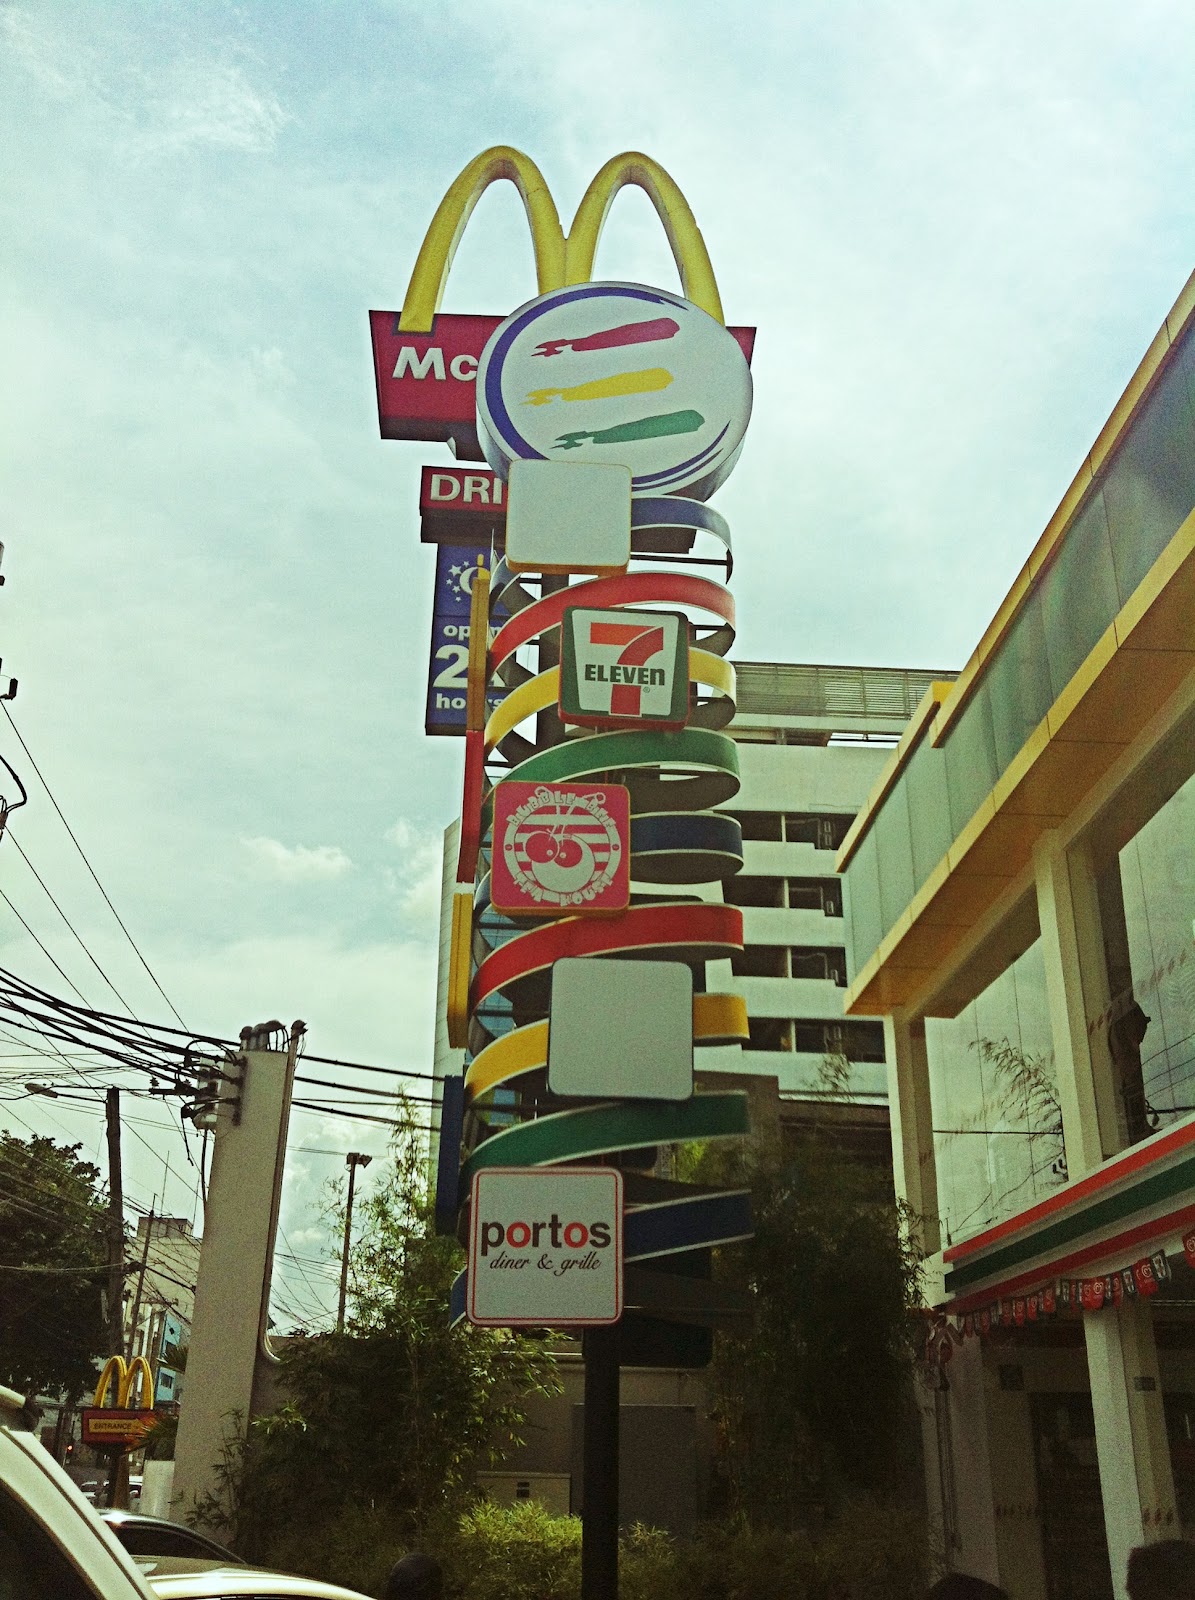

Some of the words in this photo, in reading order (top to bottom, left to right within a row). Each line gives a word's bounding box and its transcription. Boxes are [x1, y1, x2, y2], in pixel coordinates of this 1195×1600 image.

[392, 346, 479, 381] Mc
[430, 474, 503, 504] DRI
[480, 1214, 612, 1256] portos
[489, 1250, 531, 1270] diner
[537, 1253, 553, 1270] &
[553, 1250, 601, 1277] grille
[93, 1422, 132, 1431] ENTRANCE
